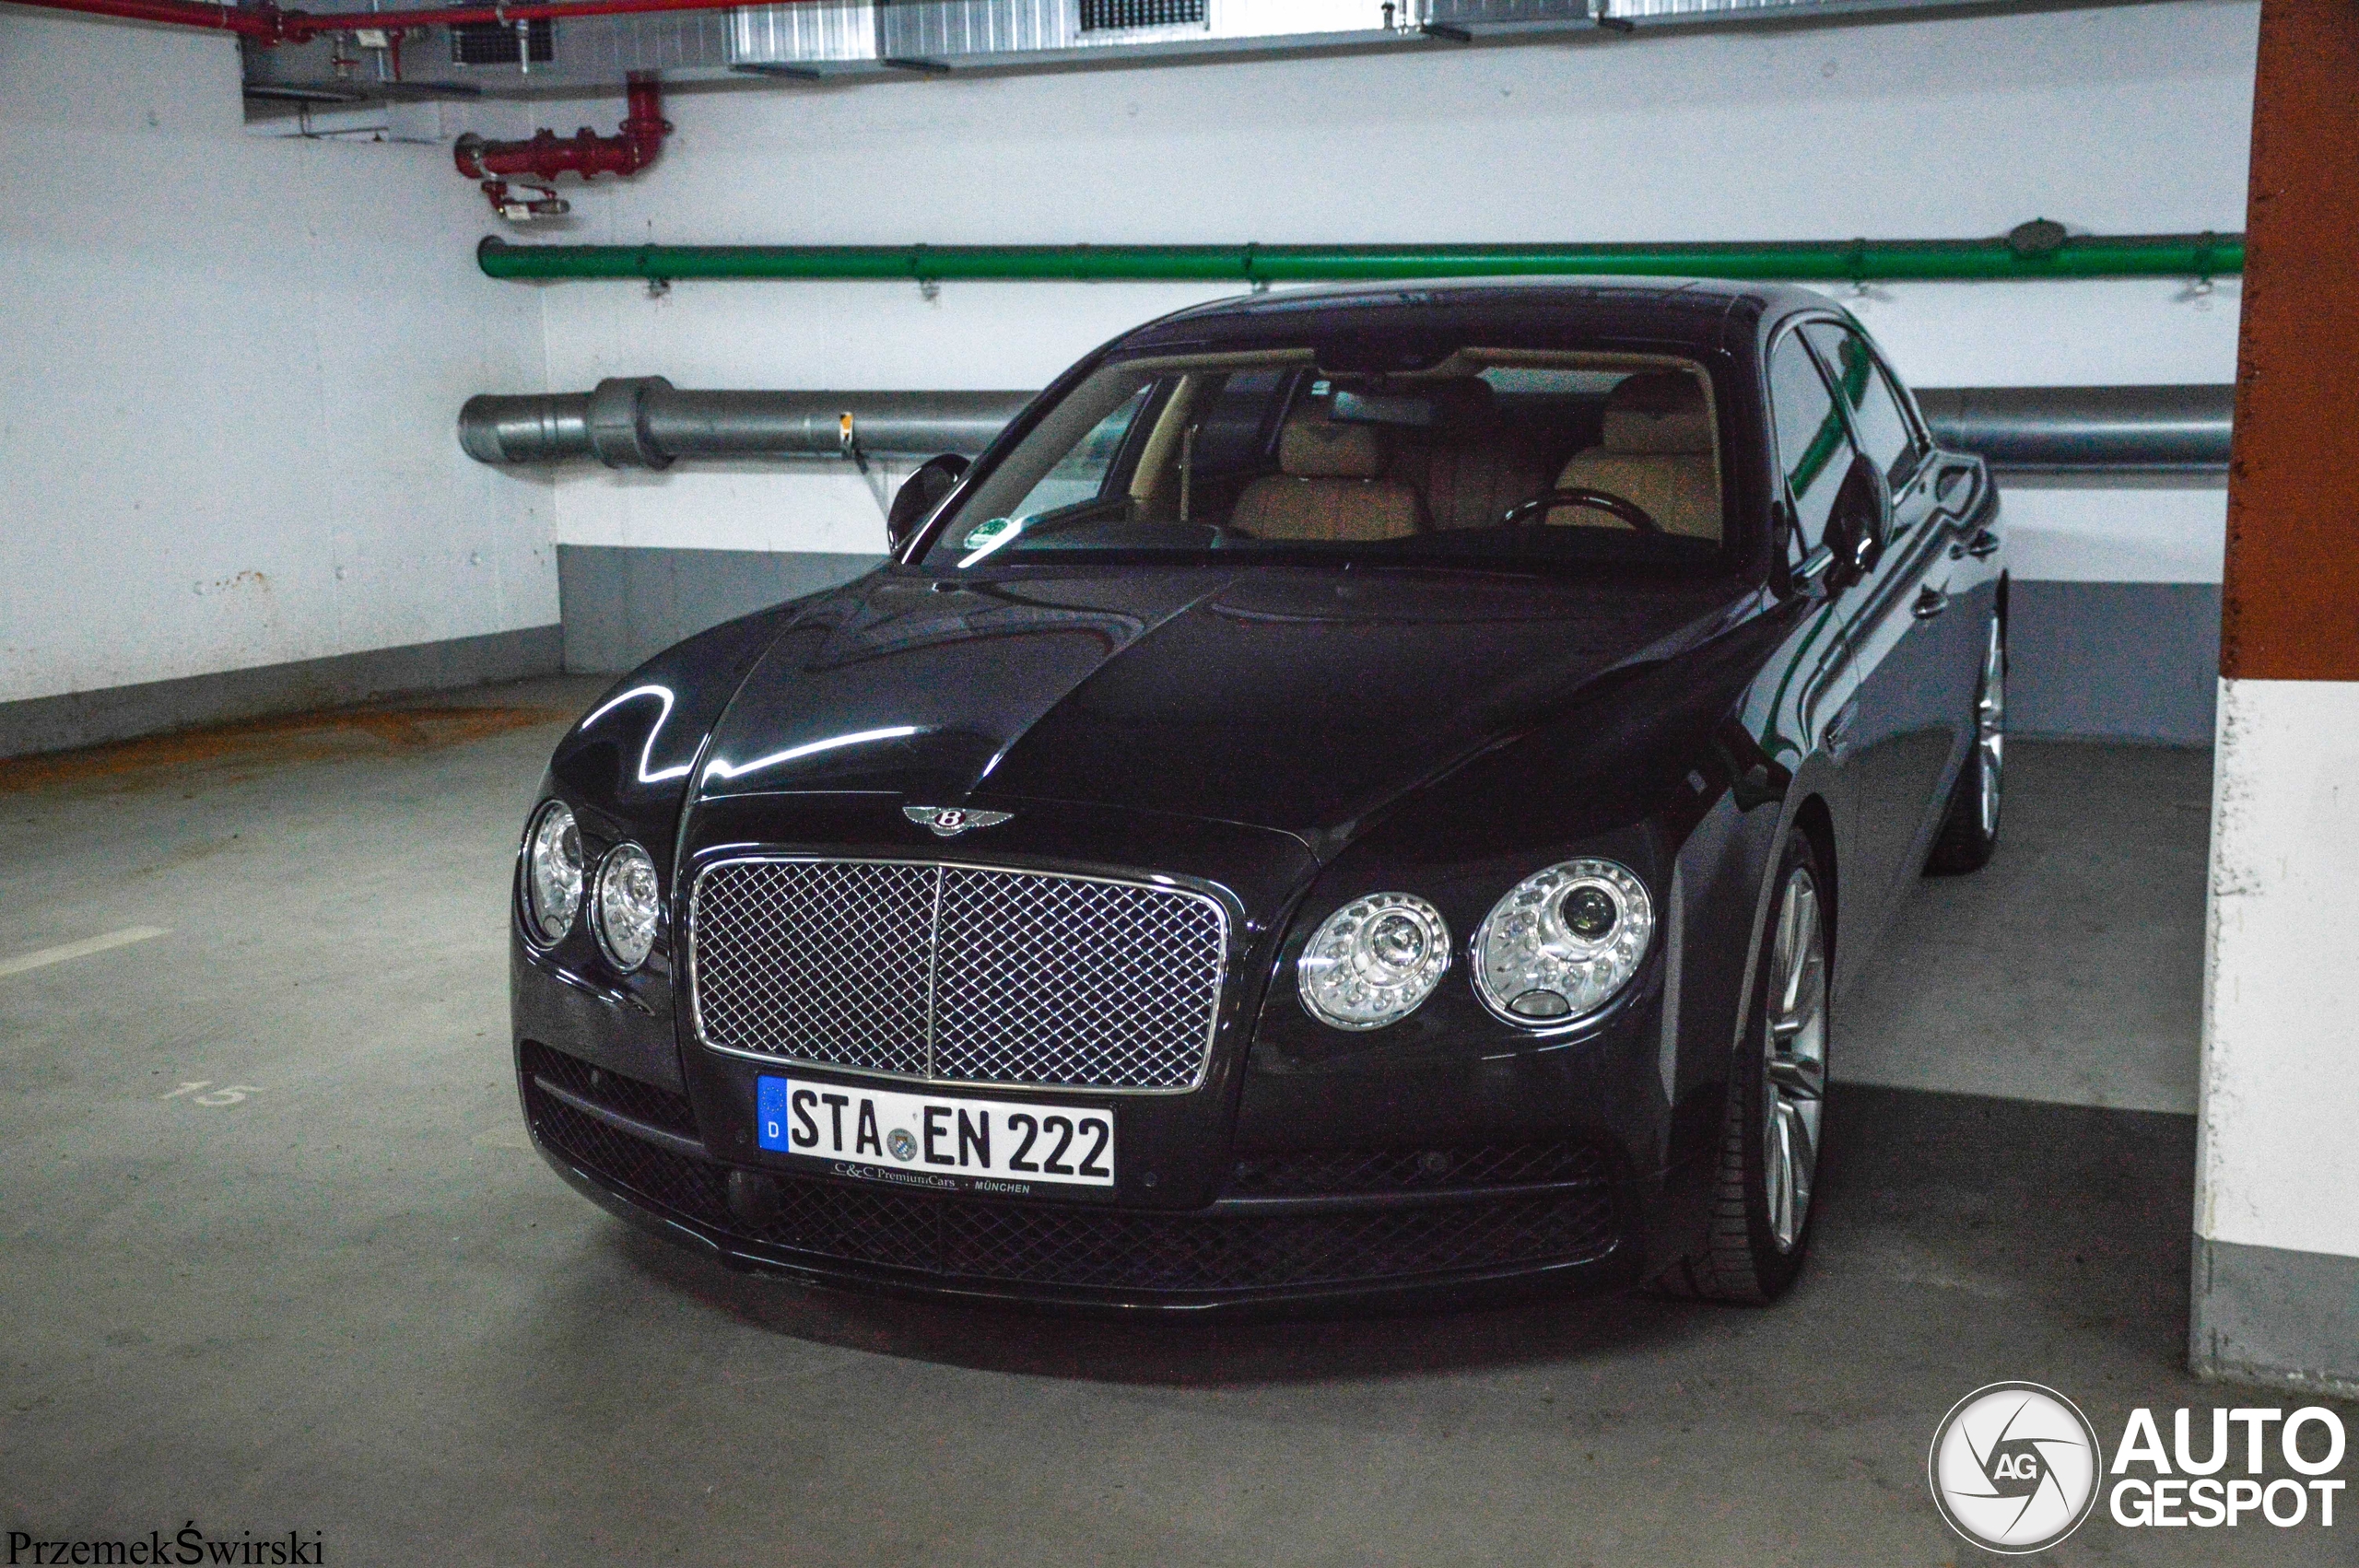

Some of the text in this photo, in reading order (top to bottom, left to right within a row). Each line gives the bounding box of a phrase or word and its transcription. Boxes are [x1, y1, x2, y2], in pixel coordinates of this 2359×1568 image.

[768, 1121, 780, 1138] D
[792, 1089, 883, 1157] STA
[924, 1106, 992, 1169] EN
[1008, 1113, 1110, 1178] 222
[834, 1163, 1030, 1194] C&C PremiumCars MÜNCHEN
